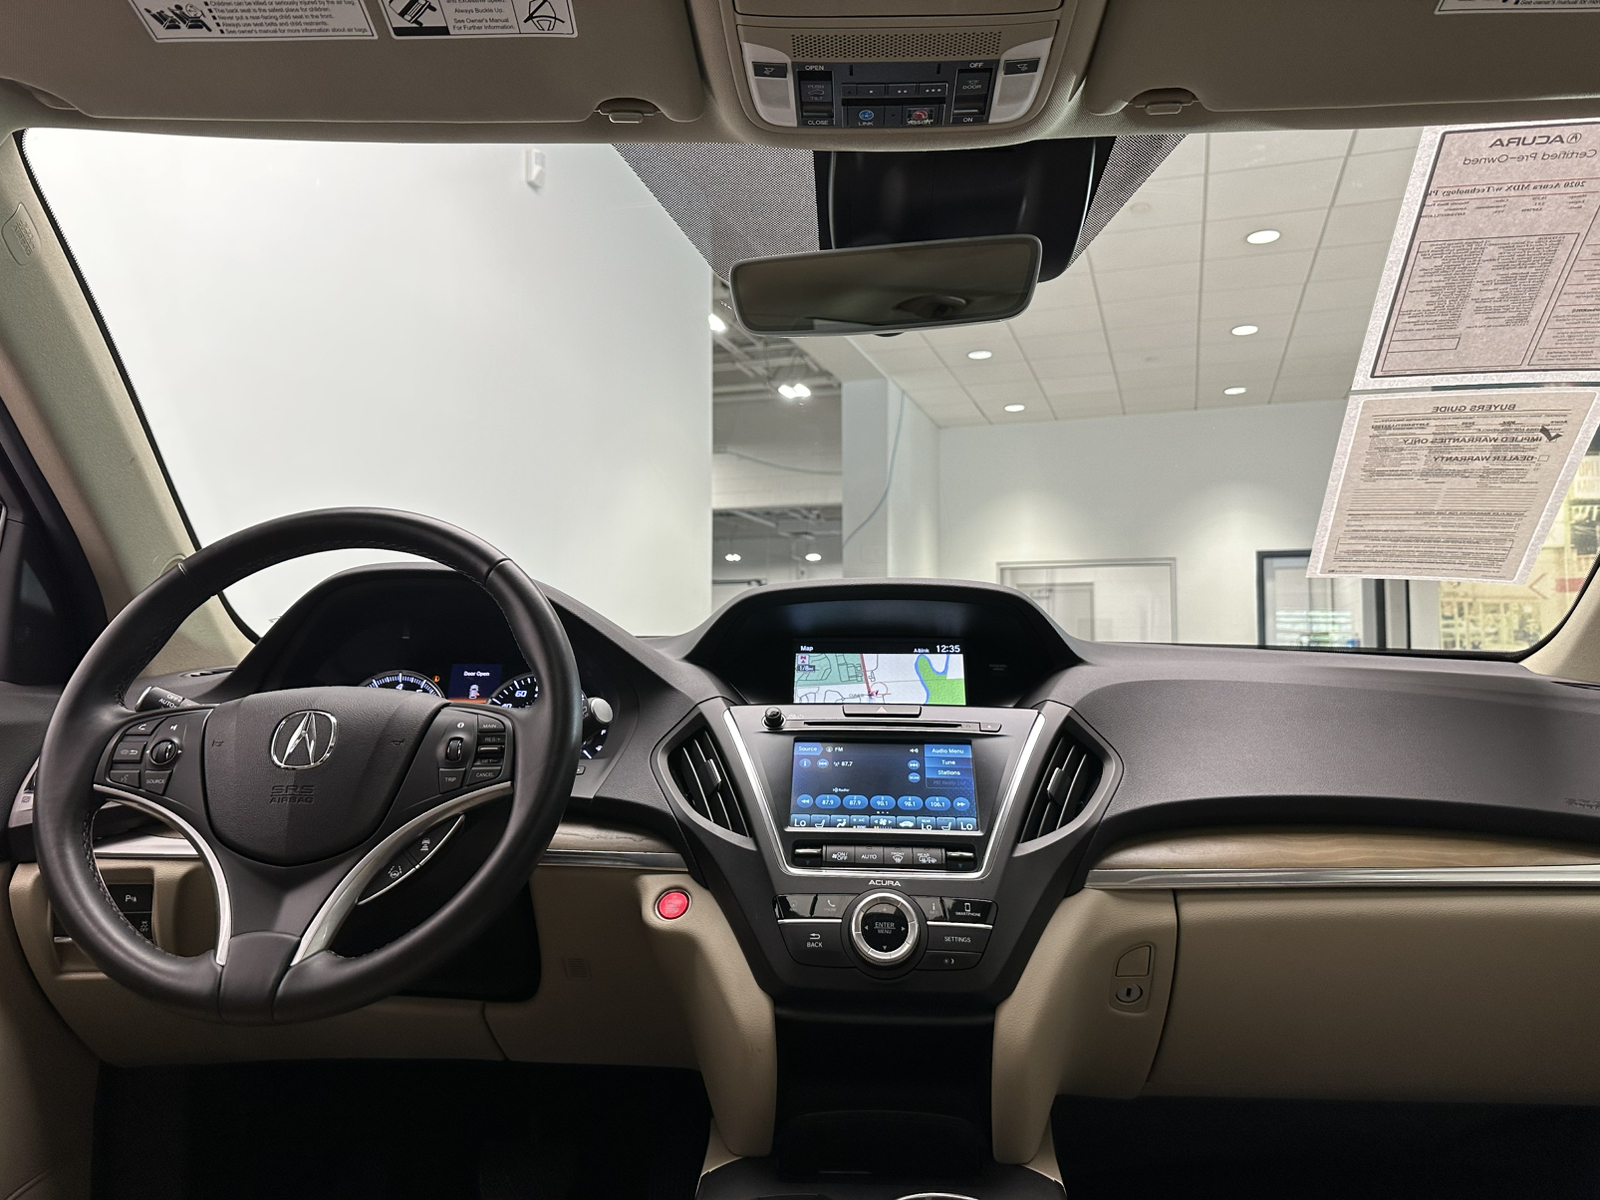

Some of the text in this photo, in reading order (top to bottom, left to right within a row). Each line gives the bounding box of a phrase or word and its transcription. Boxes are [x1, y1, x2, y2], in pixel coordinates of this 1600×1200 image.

[936, 644, 961, 653] 12:35
[158, 698, 175, 708] AUTO
[272, 785, 315, 794] SRS
